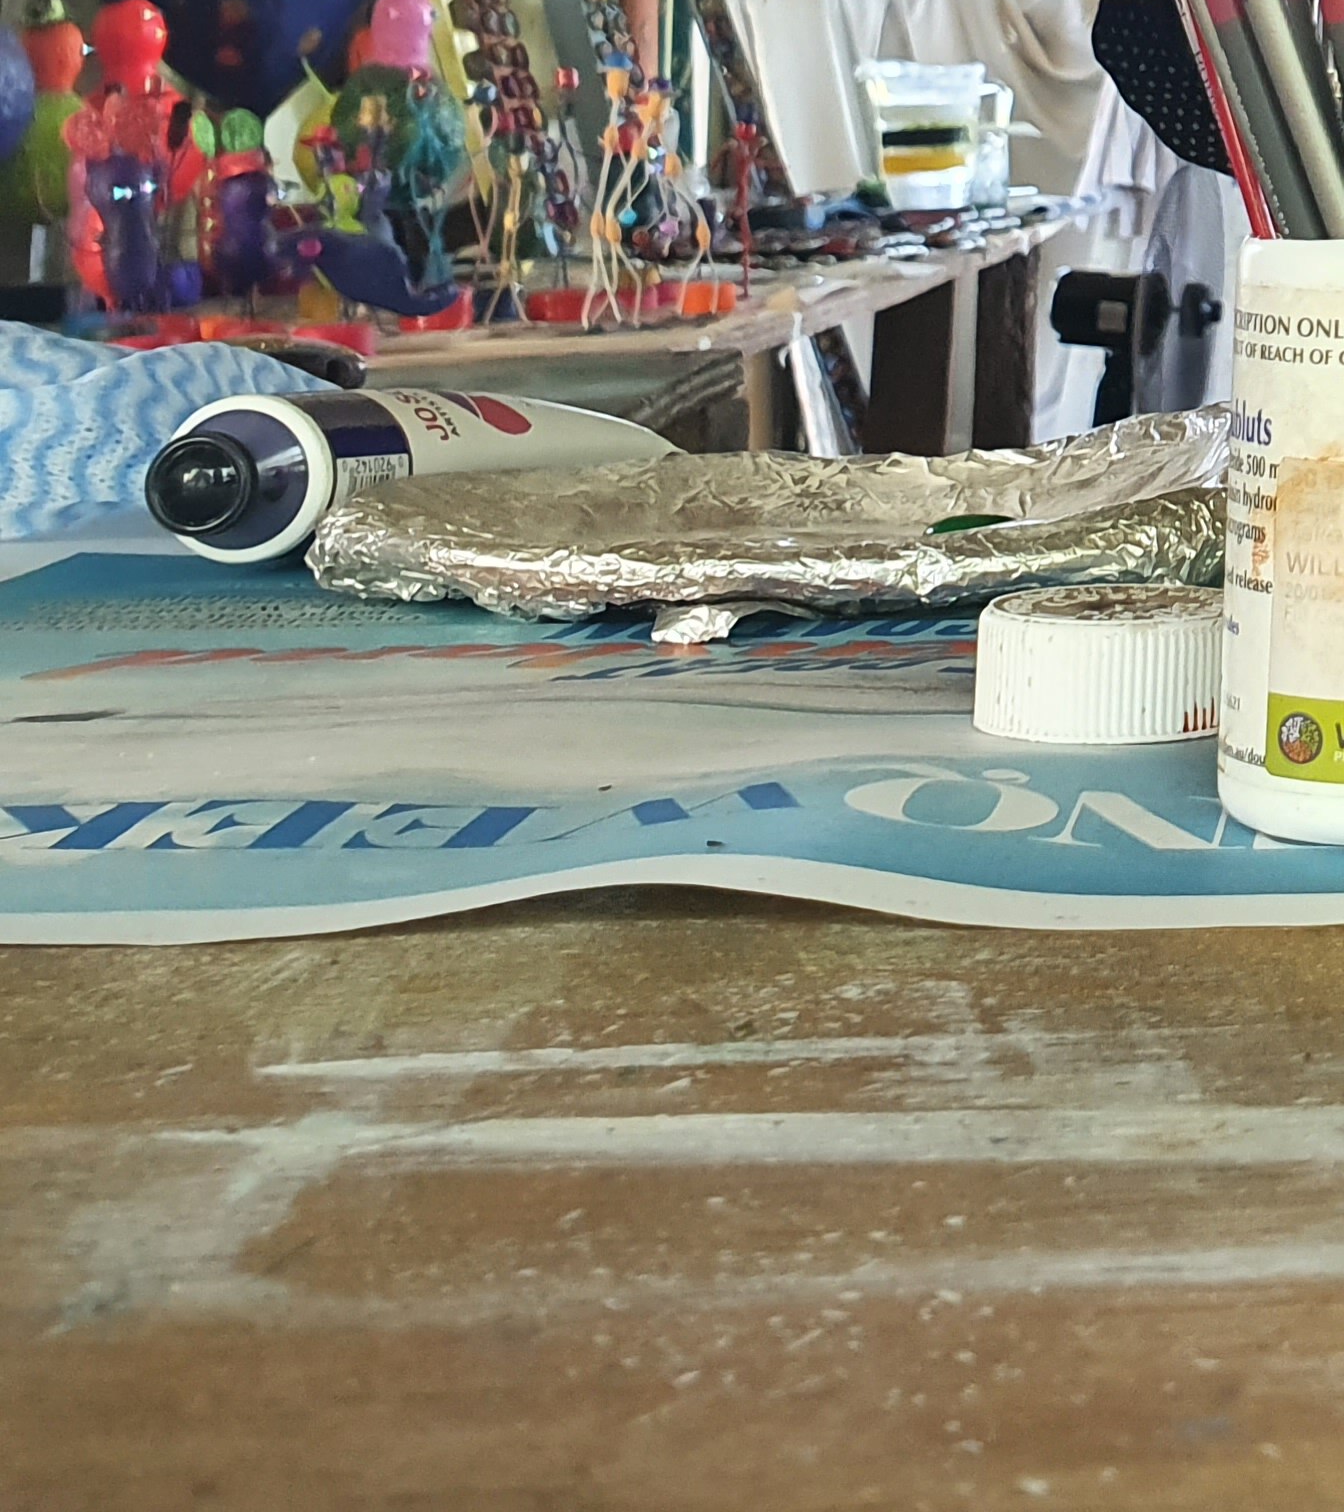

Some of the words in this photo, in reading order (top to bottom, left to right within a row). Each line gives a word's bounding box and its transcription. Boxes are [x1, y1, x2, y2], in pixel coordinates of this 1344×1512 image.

[1245, 342, 1258, 359] OF
[1260, 344, 1304, 364] REACH
[1309, 348, 1333, 366] OF
[1246, 453, 1265, 478] 500
[1242, 482, 1277, 514] hydro
[1235, 569, 1274, 594] release
